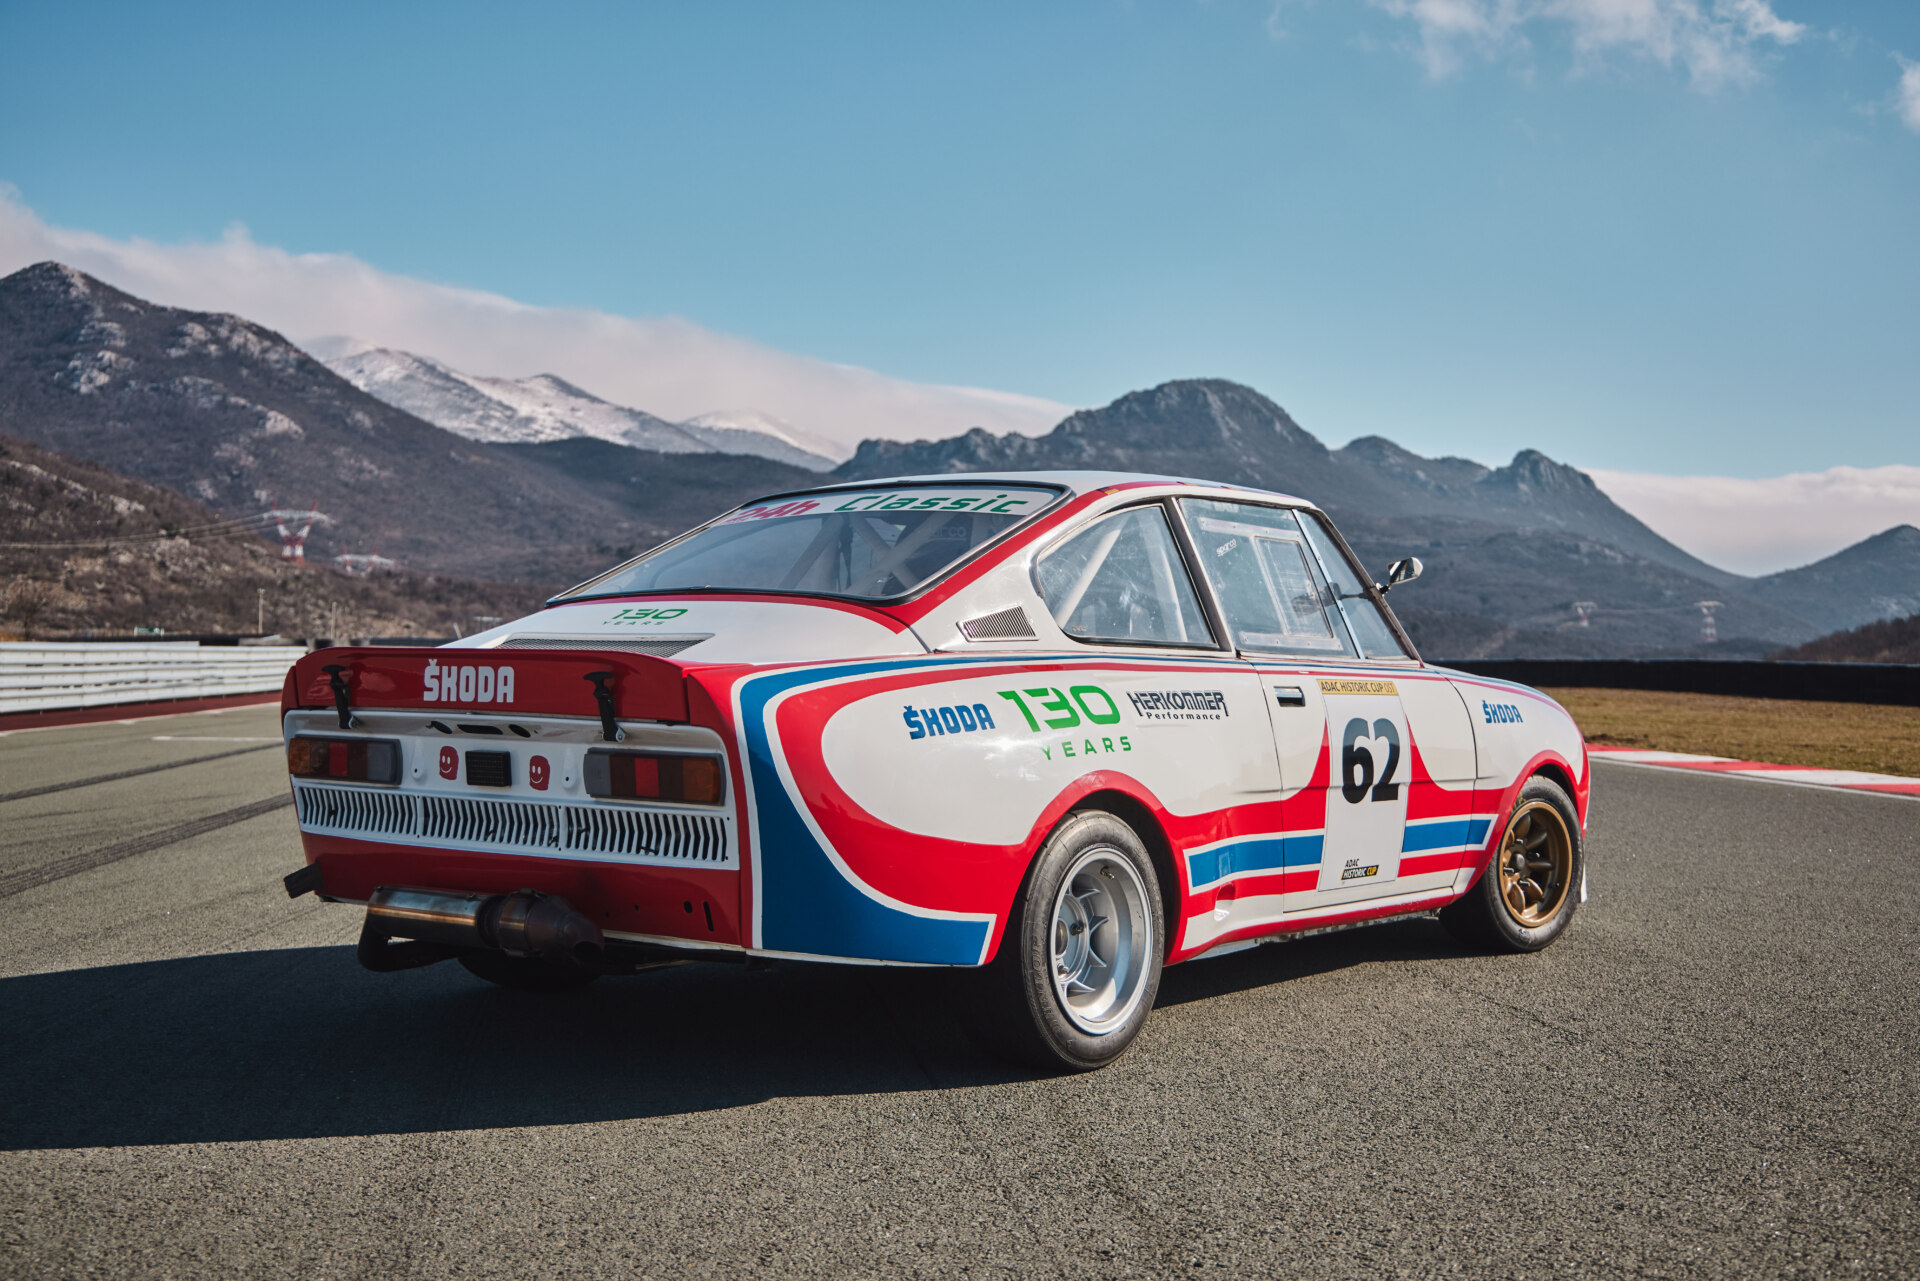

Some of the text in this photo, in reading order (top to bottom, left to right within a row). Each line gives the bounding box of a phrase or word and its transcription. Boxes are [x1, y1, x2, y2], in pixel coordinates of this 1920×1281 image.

[725, 494, 1028, 523] 24h Classic
[1216, 539, 1237, 557] sparco
[612, 608, 688, 619] 130
[423, 659, 514, 703] ŠKODA
[1321, 681, 1340, 692] ADAC
[1341, 681, 1371, 693] HISTORIC
[1371, 682, 1383, 693] CUP
[996, 685, 1121, 732] 130
[1126, 691, 1229, 717] HERKOMMER
[1145, 712, 1221, 720] Performance
[1482, 700, 1523, 724] ŠKODA
[903, 703, 996, 740] ŠKODA
[1041, 736, 1132, 761] YEARS
[1342, 717, 1400, 804] 62
[1343, 866, 1377, 878] HISTORIC CUP
[1345, 858, 1360, 867] ADAC
